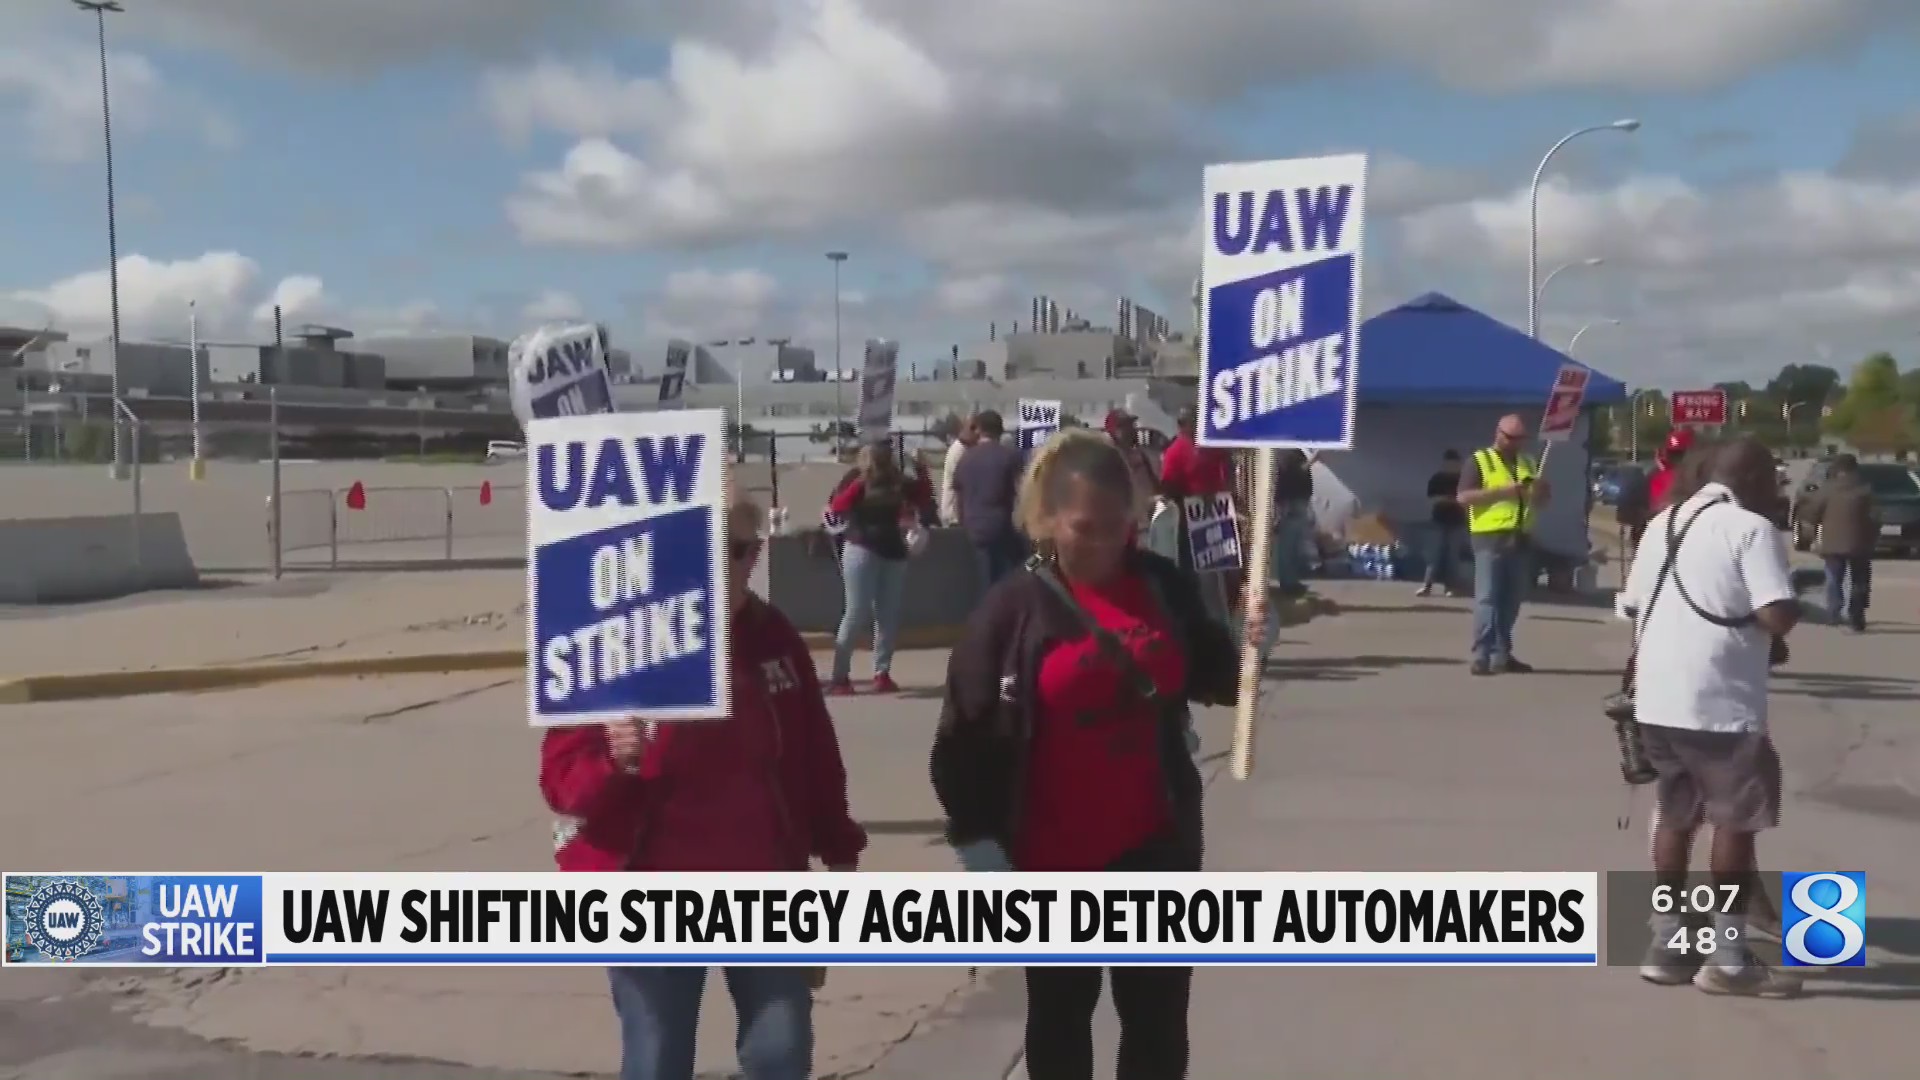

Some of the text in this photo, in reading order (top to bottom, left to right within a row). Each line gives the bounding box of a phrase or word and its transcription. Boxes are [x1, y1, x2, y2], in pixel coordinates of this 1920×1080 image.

[1213, 184, 1353, 256] UAW
[1252, 275, 1305, 348] ON
[1021, 404, 1057, 423] UAW
[1211, 331, 1345, 429] STRIKE
[537, 432, 707, 511] UAW
[591, 531, 655, 610] ON
[544, 587, 706, 701] STRIKE
